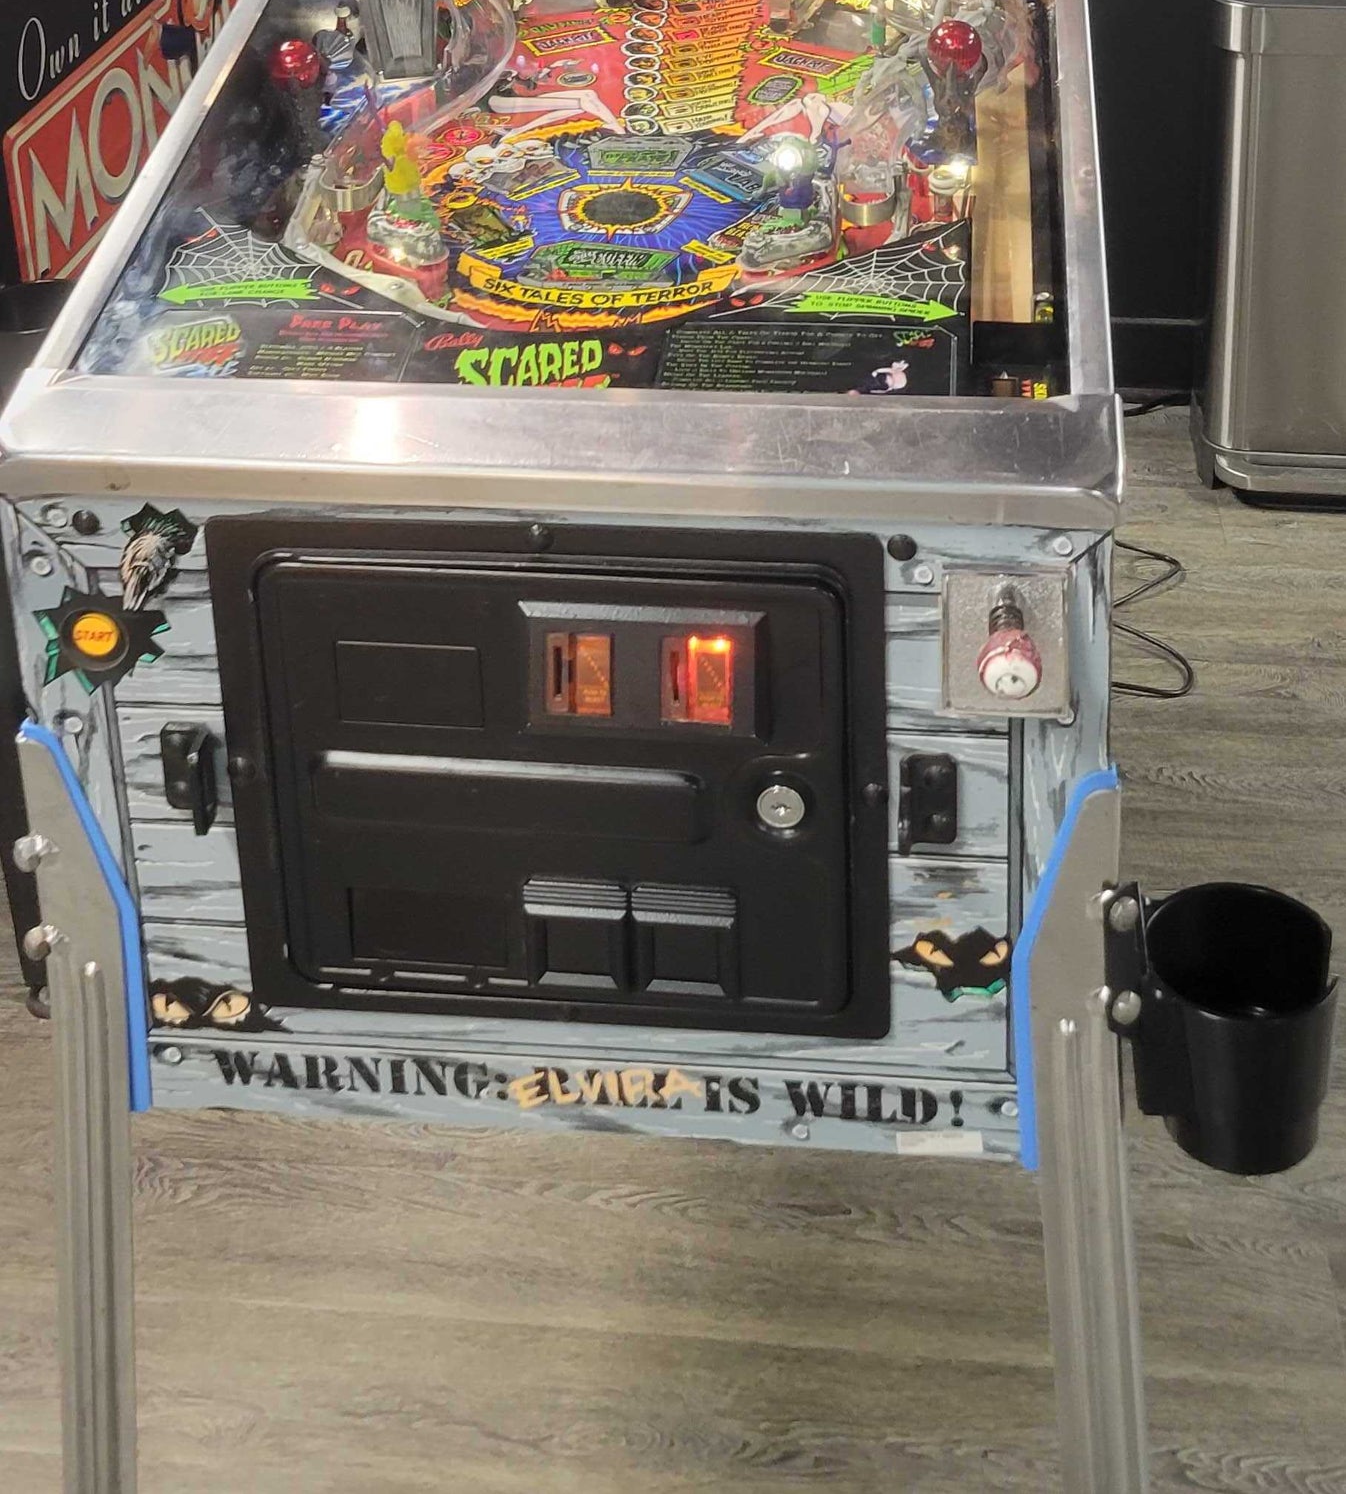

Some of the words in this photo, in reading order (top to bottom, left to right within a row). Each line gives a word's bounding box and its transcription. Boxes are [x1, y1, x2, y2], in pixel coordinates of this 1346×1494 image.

[17, 16, 80, 101] Own
[484, 277, 515, 294] SIX
[520, 288, 583, 305] TALES
[591, 292, 624, 305] OF
[632, 280, 713, 305] TERROR
[424, 332, 484, 351] Bally
[454, 339, 603, 386] SCARED
[73, 629, 114, 644] START
[210, 1049, 509, 1100] WARNING:
[508, 1067, 702, 1110] ELVIRA
[702, 1074, 761, 1115] IS
[783, 1077, 964, 1127] WILD!
